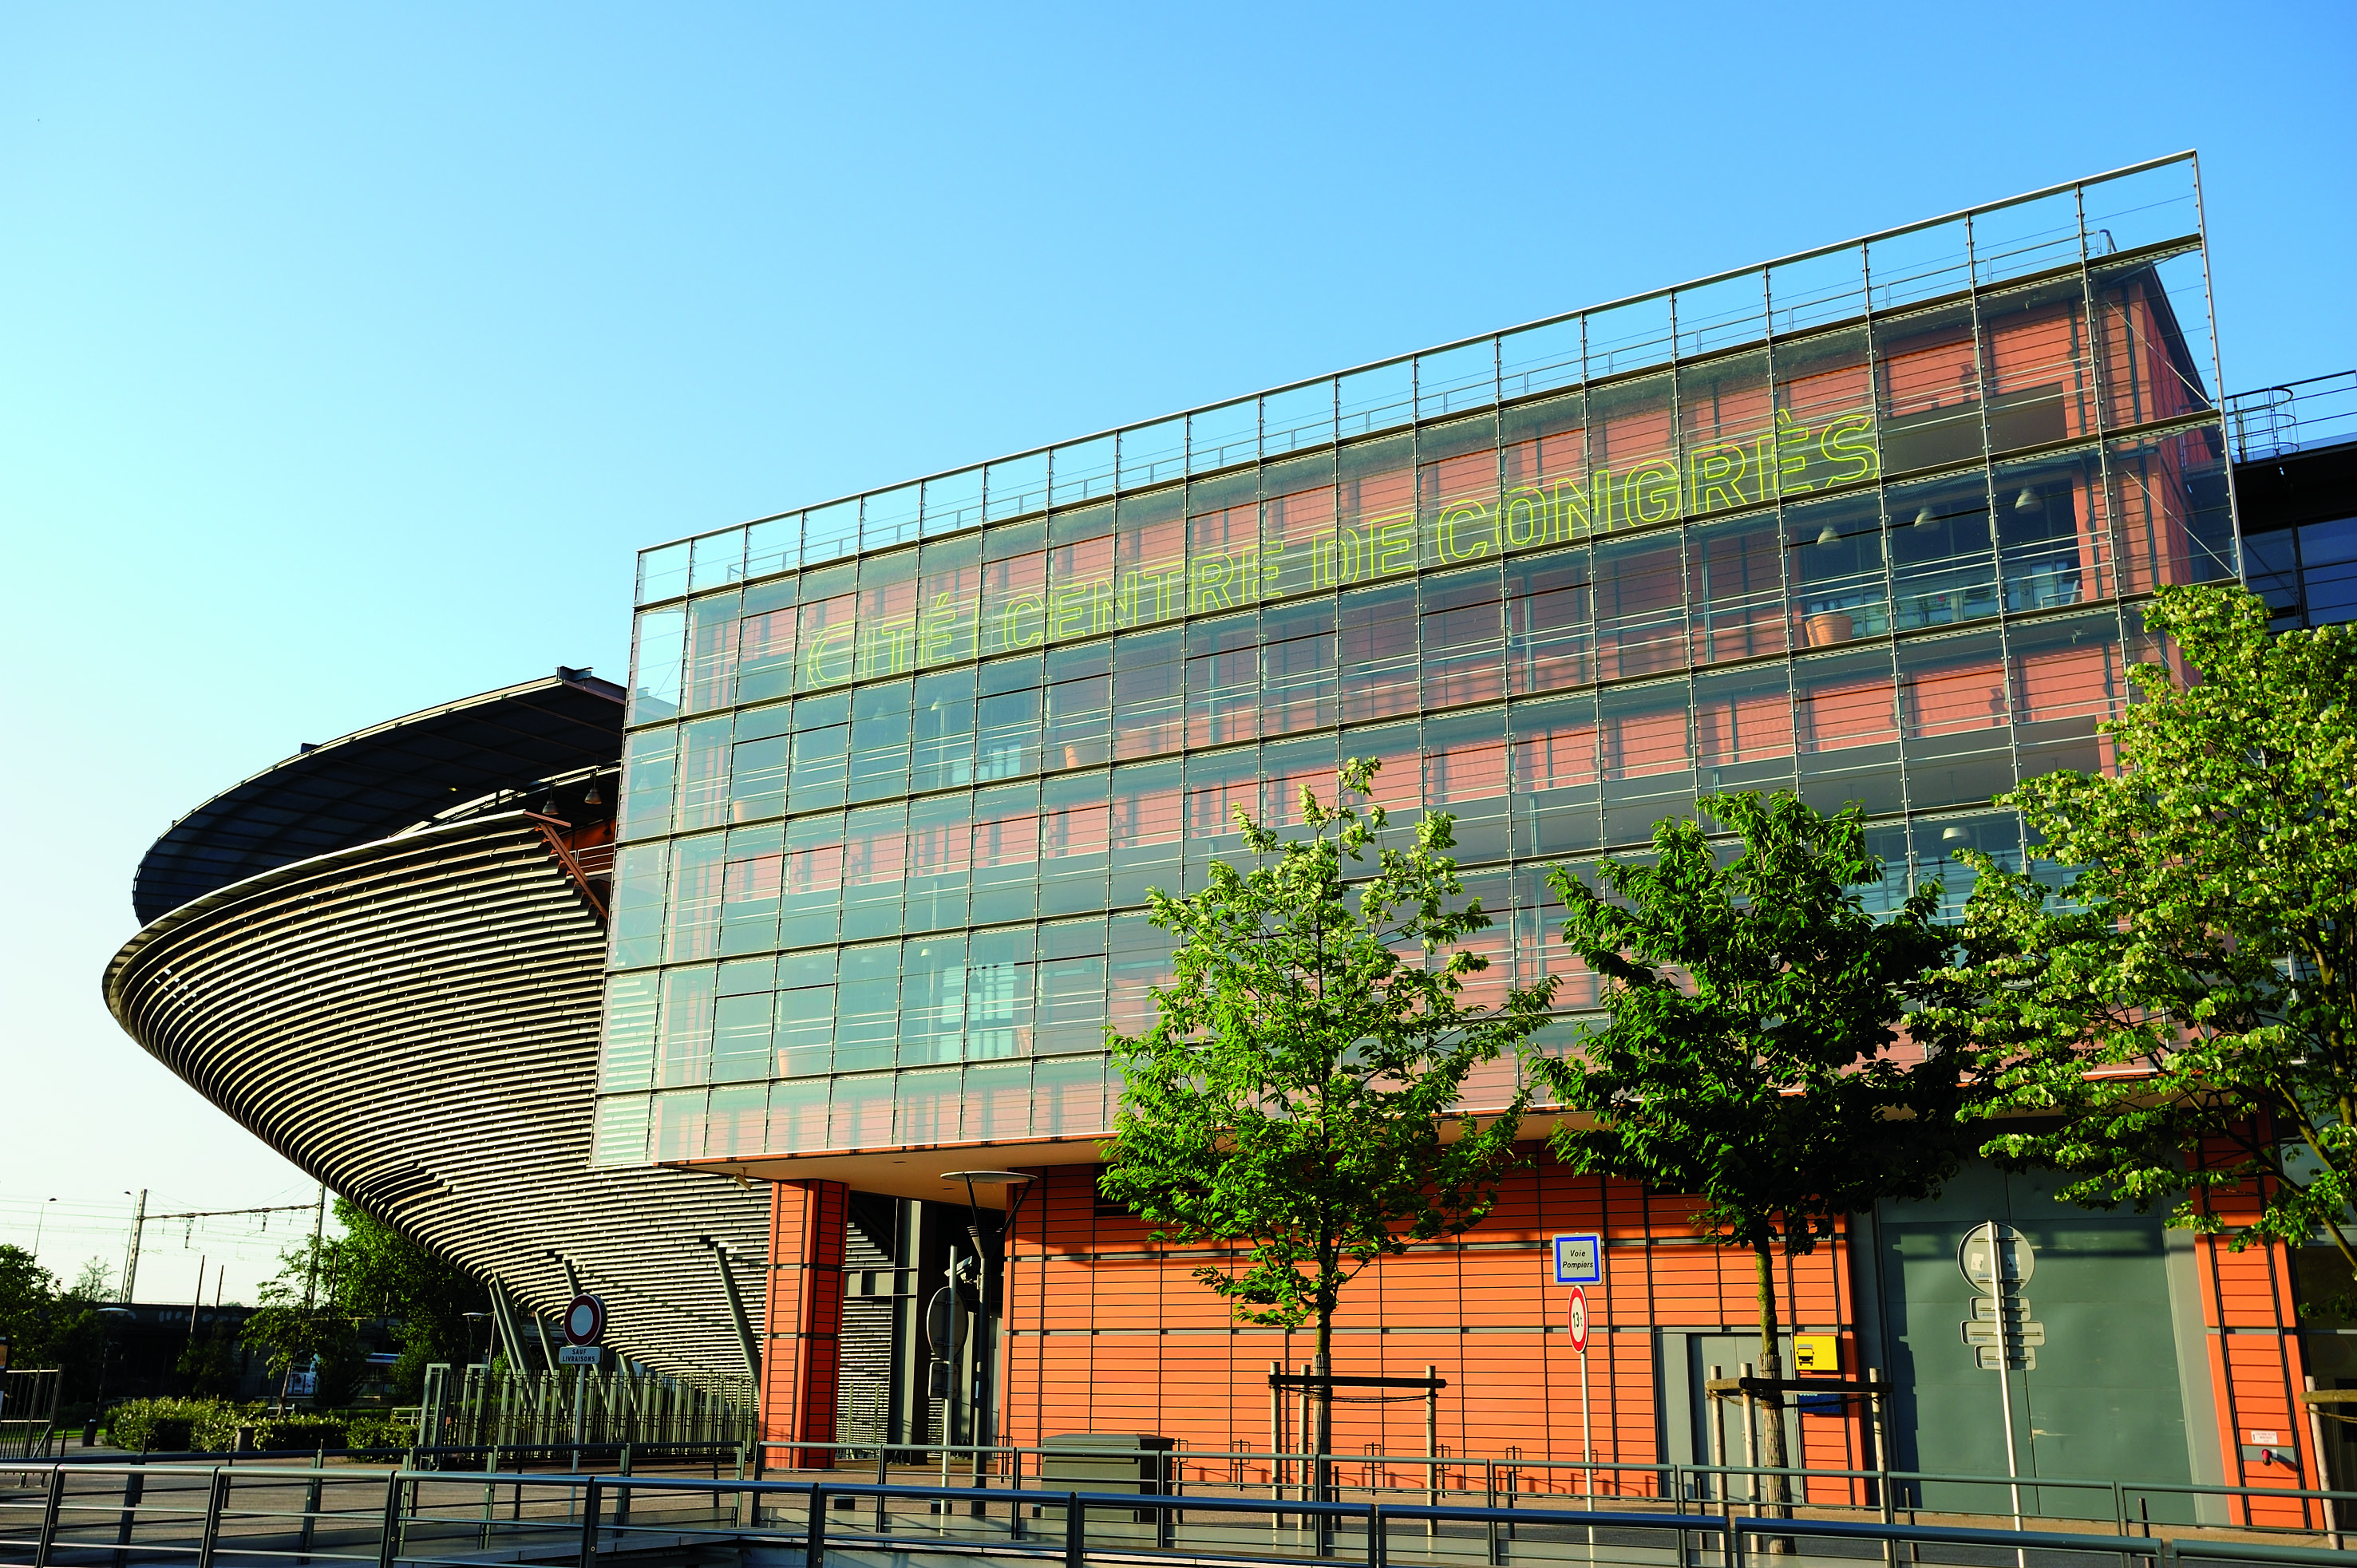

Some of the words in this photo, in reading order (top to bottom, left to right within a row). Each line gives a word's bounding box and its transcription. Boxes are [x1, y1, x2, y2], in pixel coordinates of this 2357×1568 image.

[807, 591, 956, 689] CITÉ
[1003, 539, 1283, 652] CENTRE
[1312, 512, 1414, 590] DE
[1437, 408, 1880, 565] CONGRÈS
[1562, 1260, 1594, 1270] Pompiers
